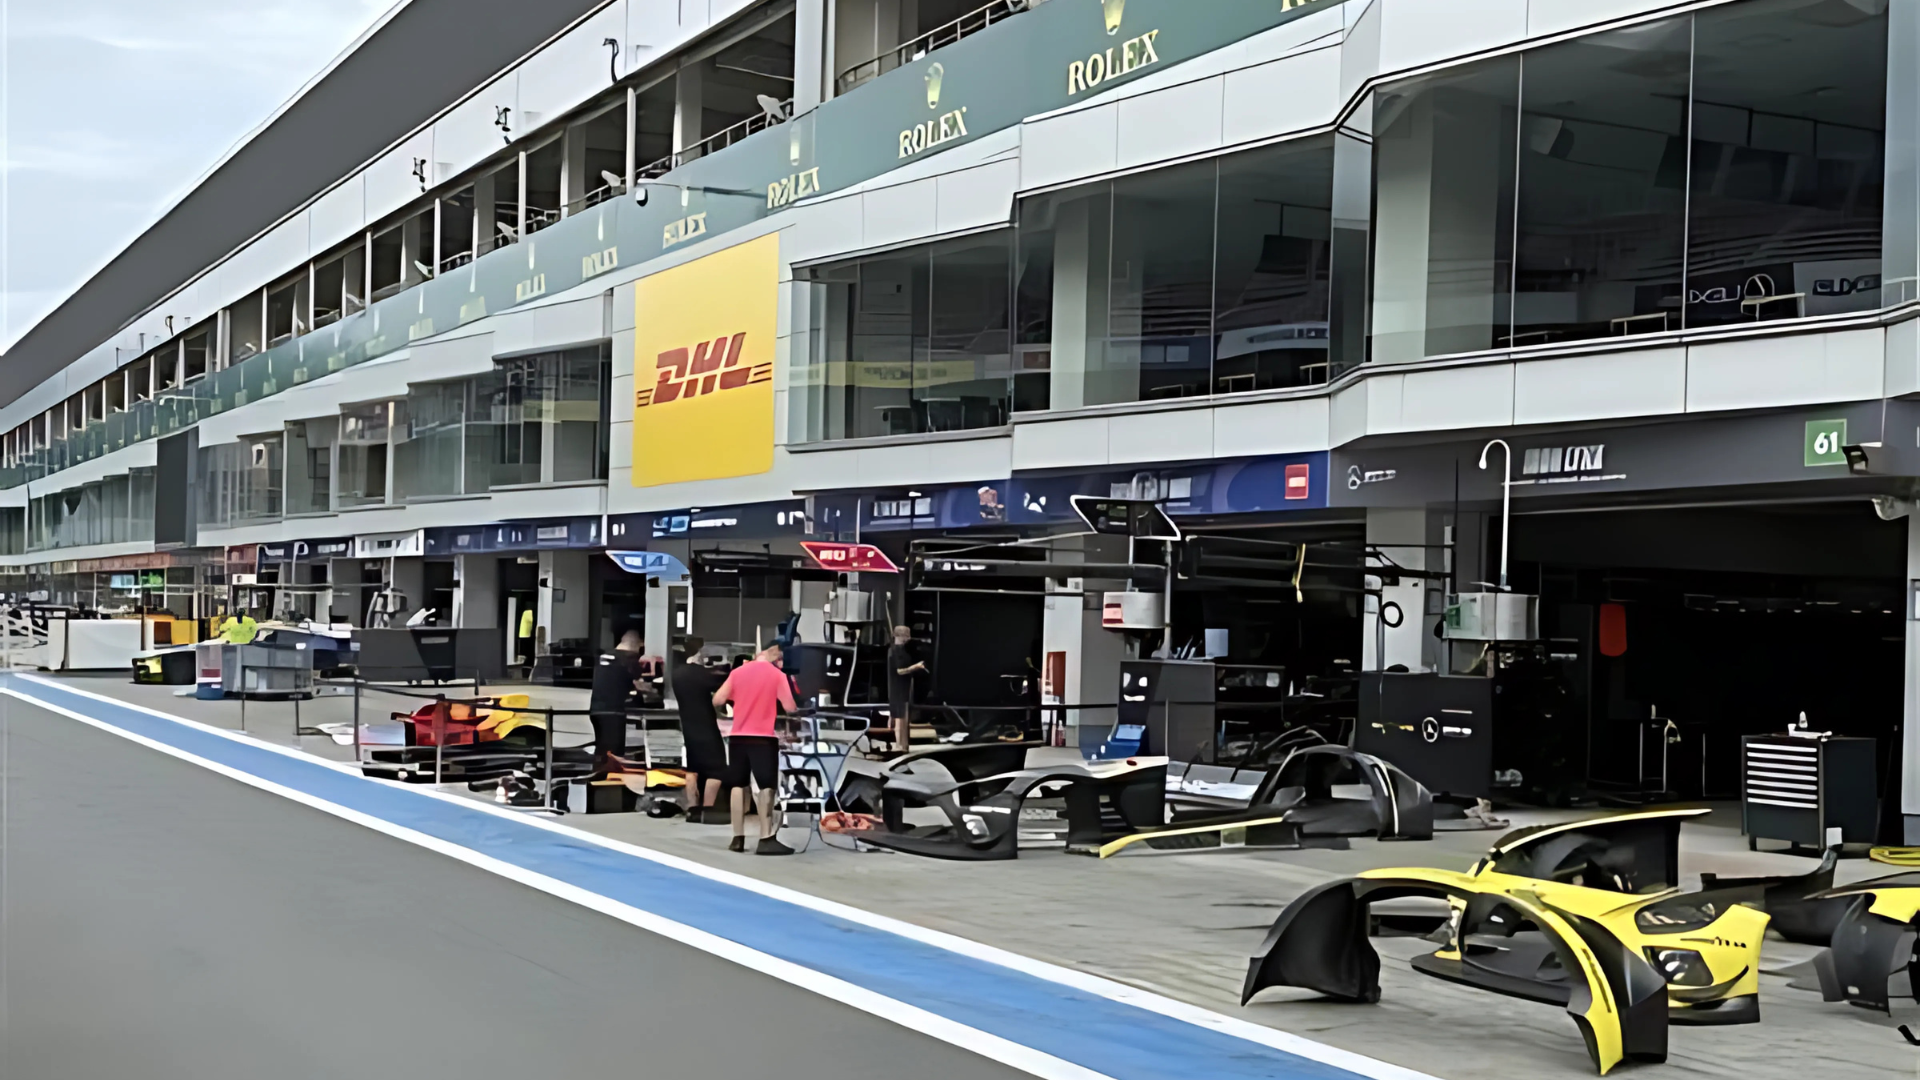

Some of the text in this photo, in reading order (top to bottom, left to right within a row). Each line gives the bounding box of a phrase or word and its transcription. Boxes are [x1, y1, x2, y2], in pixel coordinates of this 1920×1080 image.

[1067, 29, 1159, 96] ROLEX
[898, 105, 968, 159] ROLEX
[652, 331, 752, 405] DHL
[1813, 431, 1838, 455] 61
